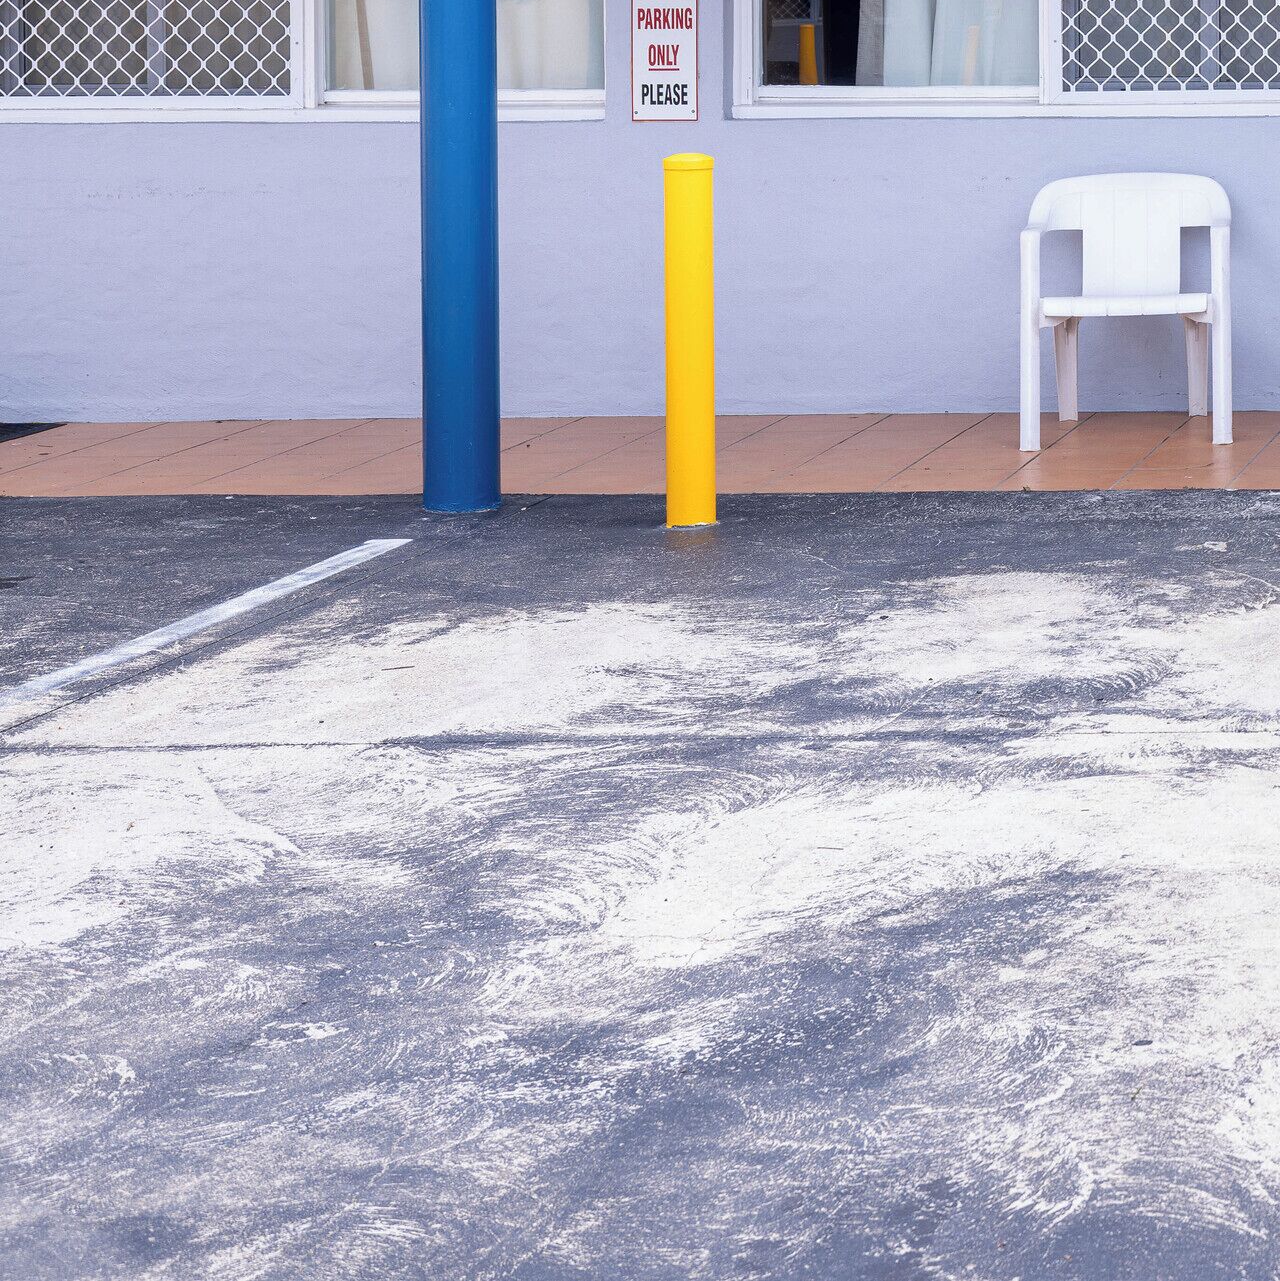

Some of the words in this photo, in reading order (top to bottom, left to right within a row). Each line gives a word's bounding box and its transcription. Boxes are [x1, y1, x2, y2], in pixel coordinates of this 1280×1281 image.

[637, 7, 693, 30] PARKING
[648, 44, 680, 66] ONLY
[641, 83, 688, 106] PLEASE
